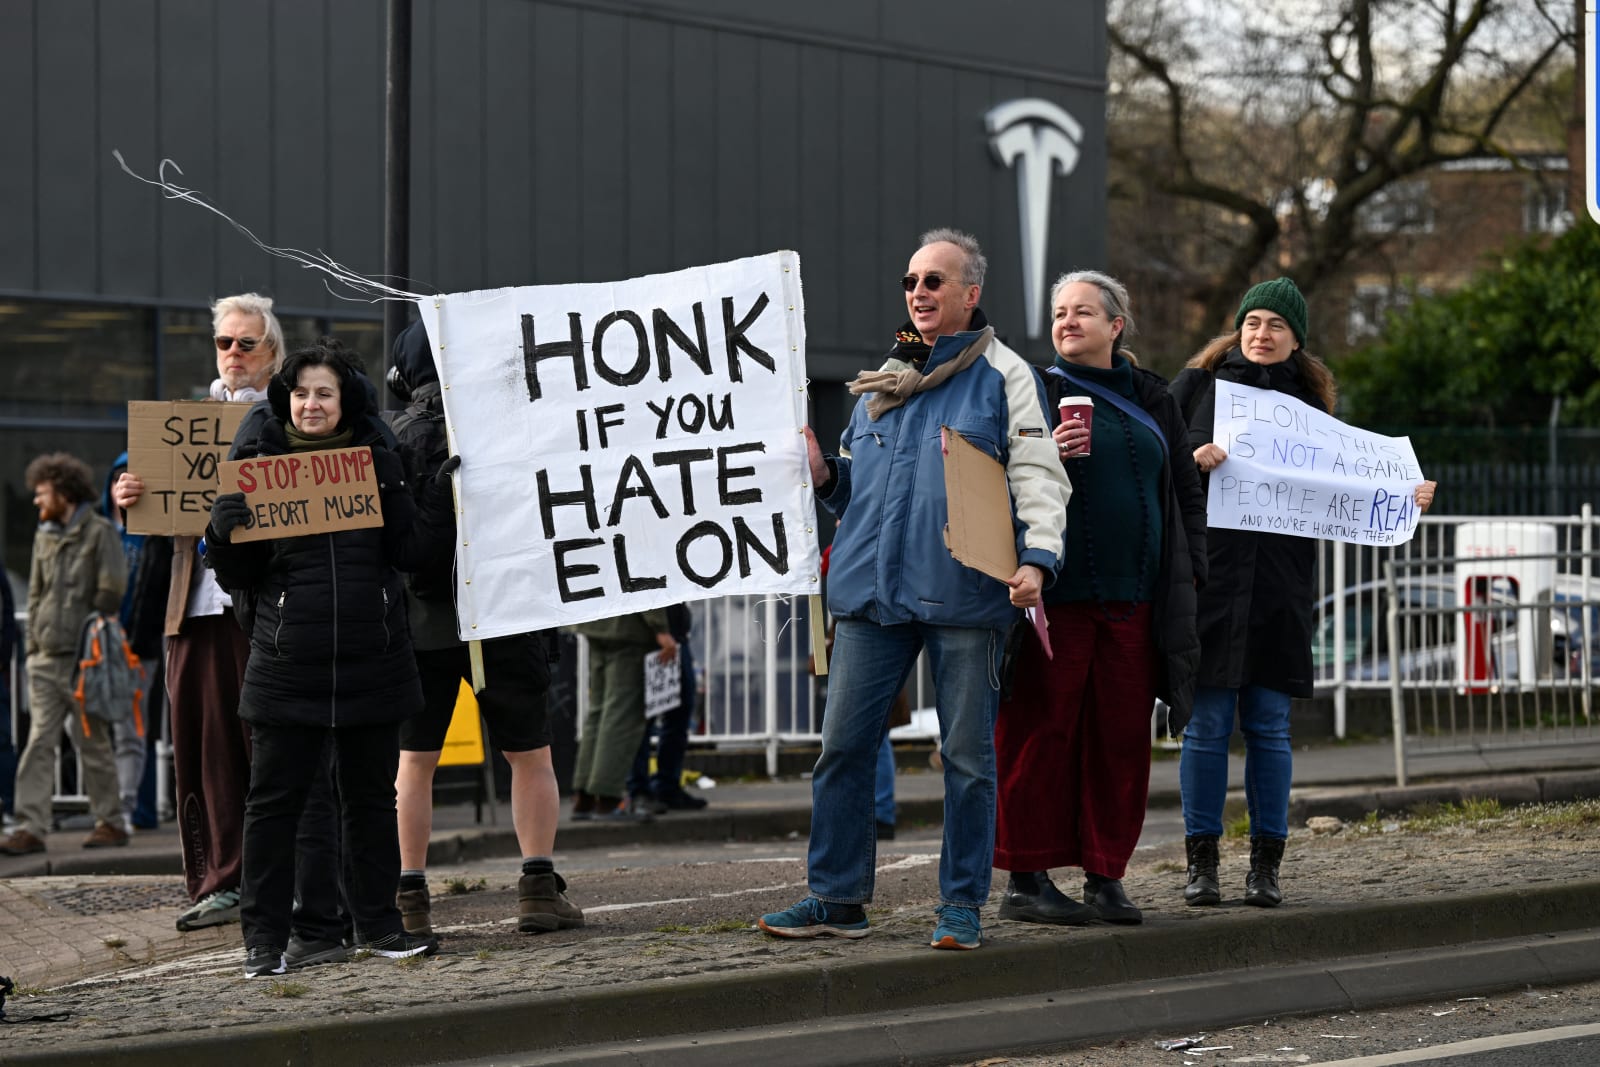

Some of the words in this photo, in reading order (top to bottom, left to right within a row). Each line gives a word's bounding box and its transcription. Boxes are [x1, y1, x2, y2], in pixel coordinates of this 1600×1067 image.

[521, 292, 776, 402] HONK
[162, 416, 232, 446] SEL
[577, 403, 624, 451] IF
[646, 393, 734, 439] YOU
[182, 451, 220, 481] YO
[1228, 432, 1256, 458] IS
[1272, 438, 1323, 471] NOT
[1333, 452, 1347, 477] A
[1355, 457, 1417, 480] GAME
[152, 490, 216, 513] TES
[324, 494, 378, 521] MUSK
[536, 442, 766, 539] HATE
[1220, 475, 1317, 514] PEOPLE
[1326, 493, 1365, 522] ARE
[1240, 514, 1262, 527] AND
[1267, 516, 1307, 532] YOU'RE
[1313, 522, 1358, 539] HURTING
[1363, 530, 1394, 543] THEM
[554, 512, 788, 602] ELON
